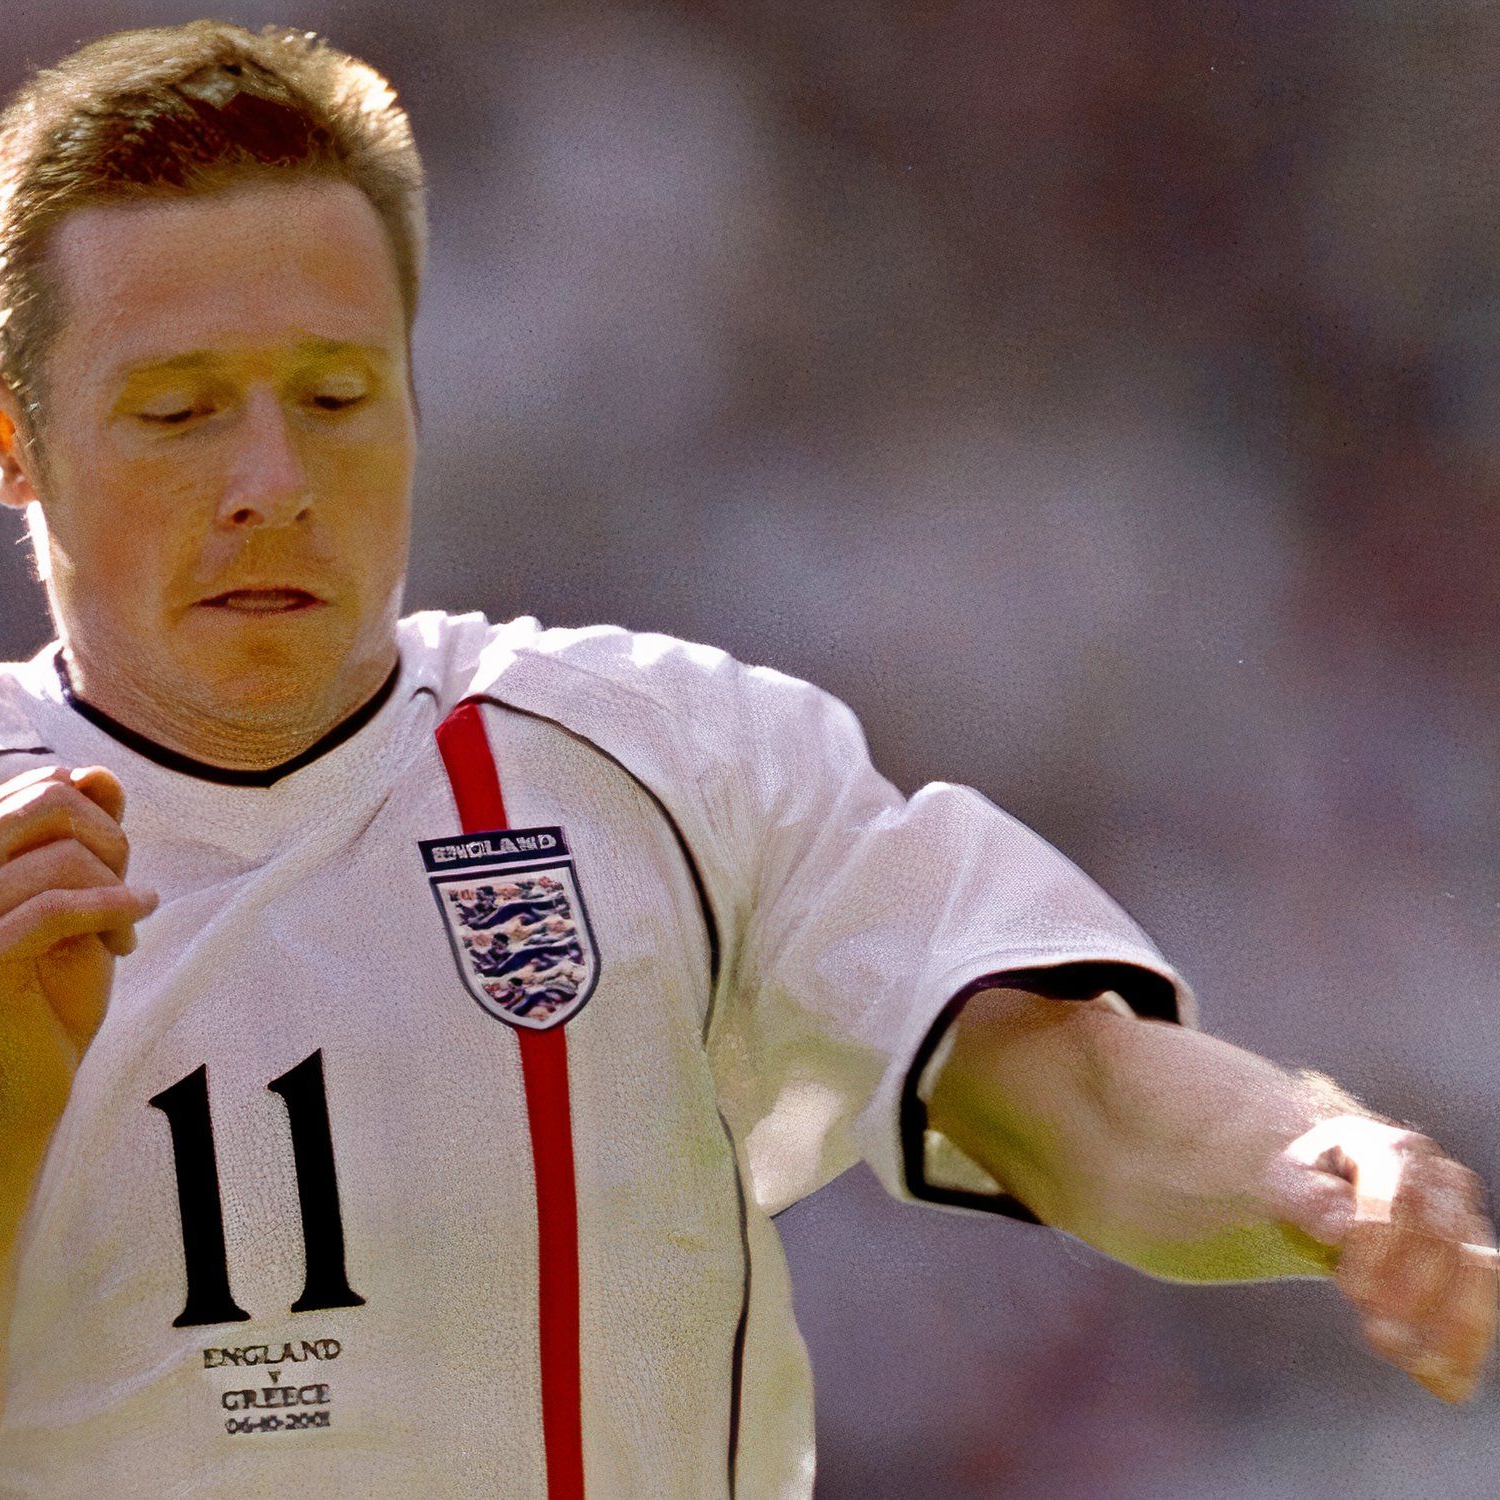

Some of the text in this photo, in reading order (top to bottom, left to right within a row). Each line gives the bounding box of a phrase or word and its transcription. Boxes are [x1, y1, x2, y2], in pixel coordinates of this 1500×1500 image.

[148, 1047, 367, 1328] 11
[203, 1338, 342, 1369] ENGLAND
[222, 1383, 331, 1411] GREECE
